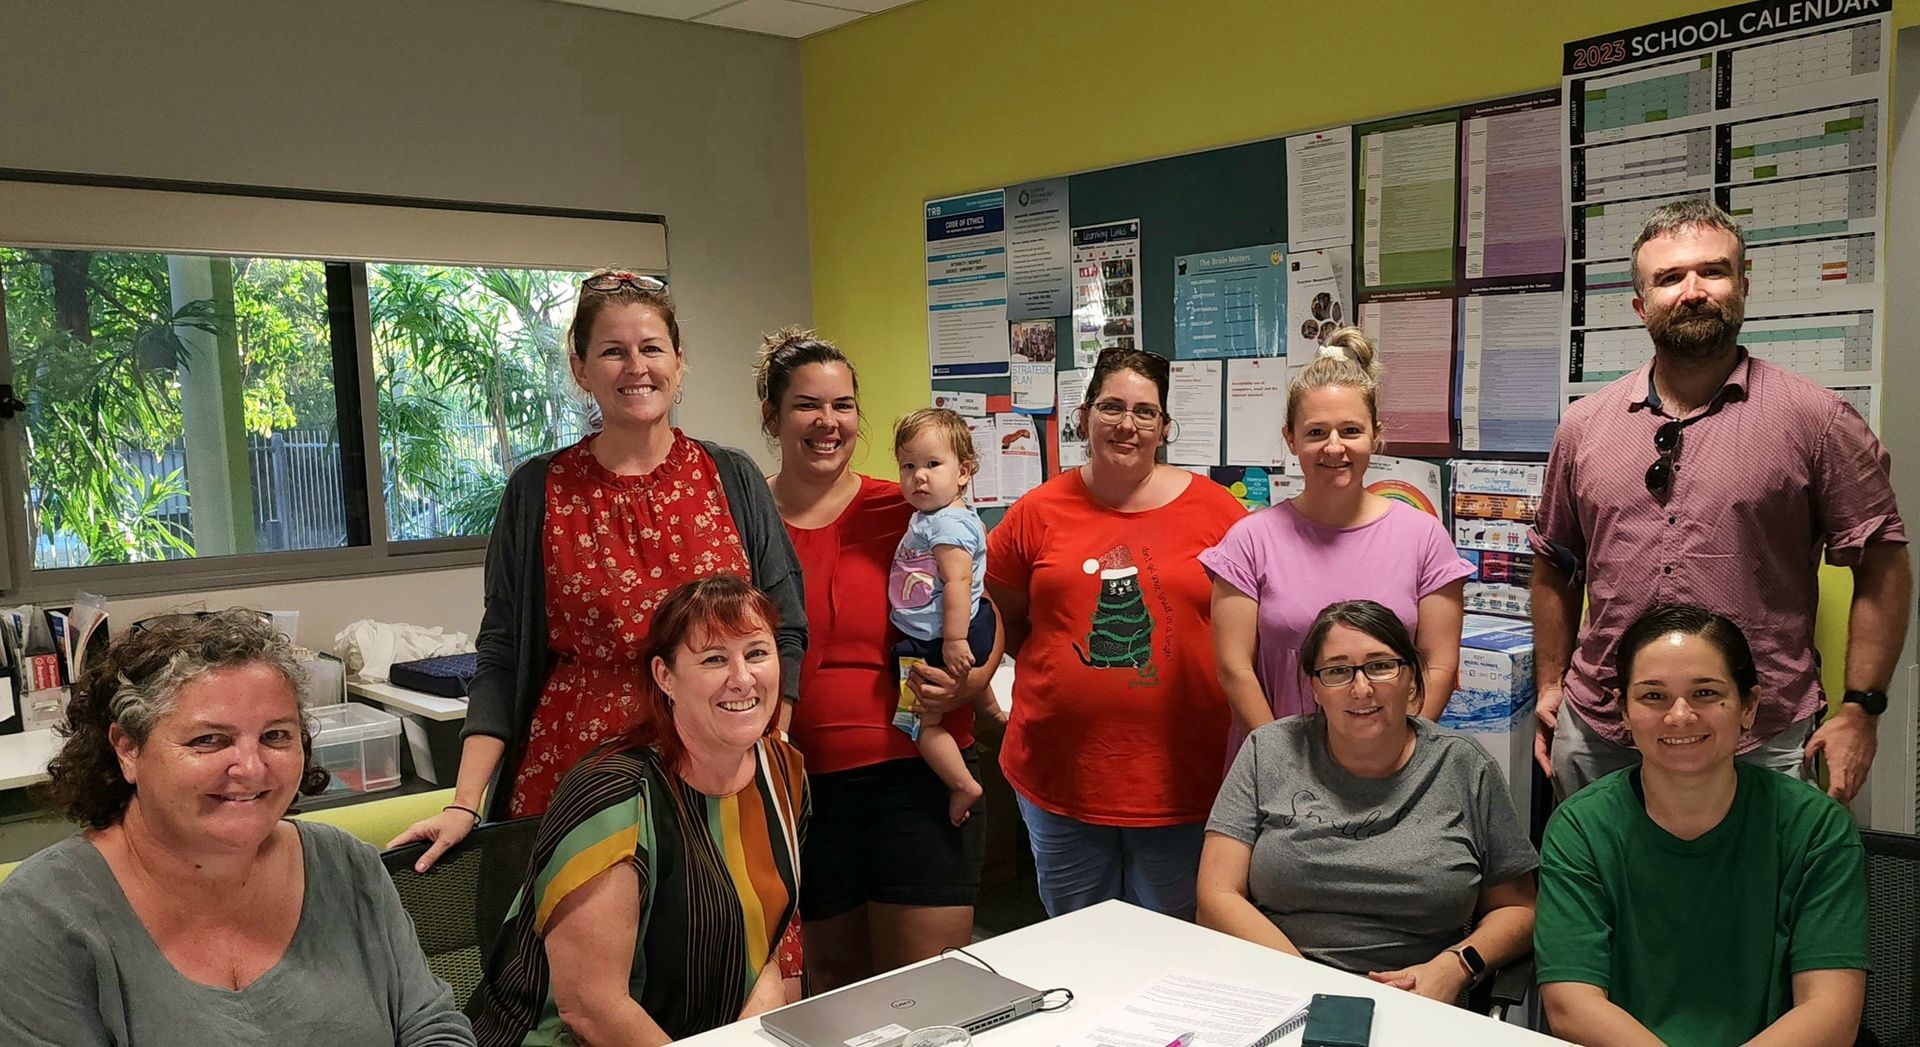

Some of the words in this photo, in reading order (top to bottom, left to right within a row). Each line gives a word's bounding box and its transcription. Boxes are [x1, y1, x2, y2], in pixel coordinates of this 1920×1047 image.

[1573, 39, 1626, 70] 2023
[1631, 18, 1732, 57] SCHOOL
[927, 206, 941, 217] TRB
[945, 220, 959, 229] CODE
[960, 219, 966, 227] OF
[966, 216, 985, 226] ETHICS
[1083, 229, 1108, 243] Learning
[1110, 226, 1127, 237] Links
[1199, 258, 1211, 266] The
[1211, 256, 1228, 265] Brain
[1228, 254, 1251, 264] Matters
[1012, 365, 1053, 375] STRATEGIC
[1012, 376, 1032, 385] PLAN
[1472, 467, 1499, 477] Mastering
[1509, 468, 1519, 476] Art
[1519, 468, 1525, 478] of
